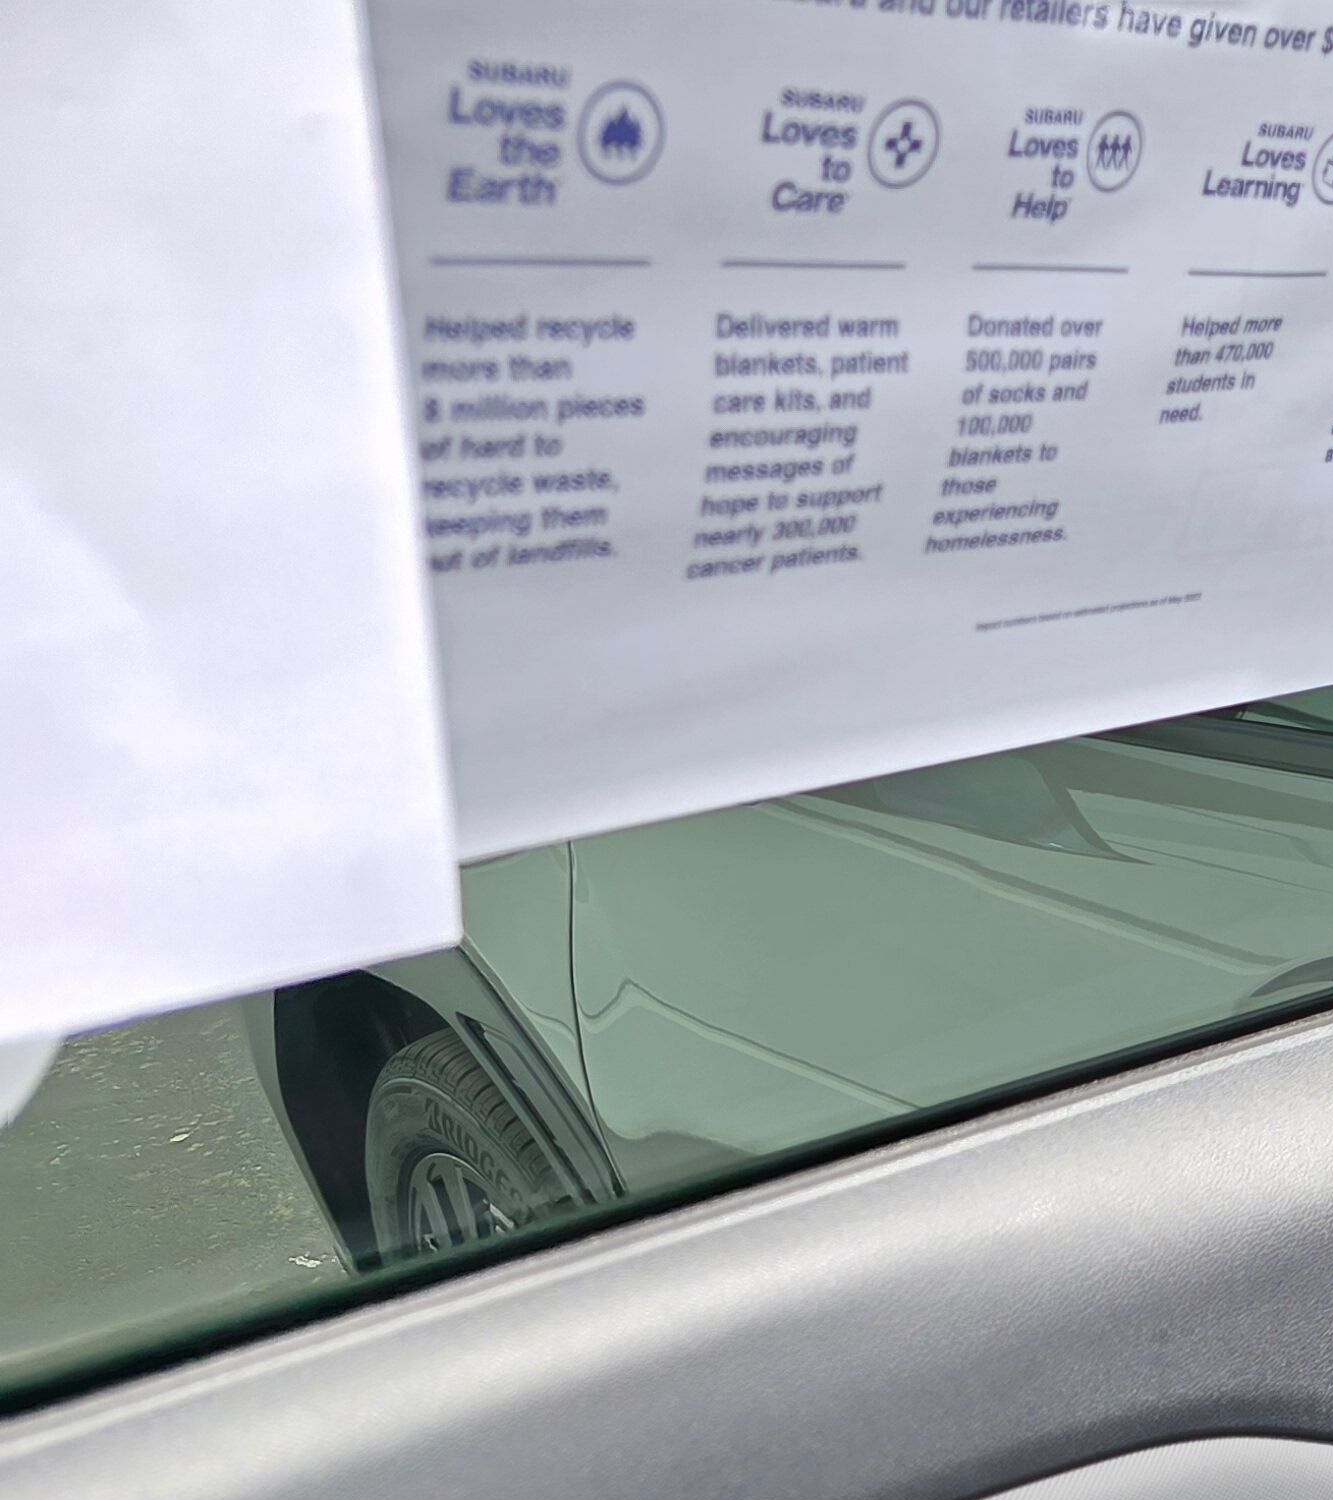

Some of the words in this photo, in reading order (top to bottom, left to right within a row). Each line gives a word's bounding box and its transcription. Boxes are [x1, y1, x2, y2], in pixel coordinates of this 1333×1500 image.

[1000, 0, 1108, 29] retailers
[1117, 0, 1182, 37] have
[1188, 12, 1257, 48] given
[1263, 27, 1316, 53] over
[467, 60, 573, 88] SUBARU
[447, 83, 567, 129] Loves
[780, 87, 866, 113] SUBARU
[761, 110, 858, 149] Loves
[1024, 108, 1084, 125] SUBARU
[1007, 128, 1080, 159] Loves
[1257, 123, 1316, 142] SUBARU
[499, 133, 561, 168] the
[1240, 140, 1307, 171] Loves
[821, 154, 852, 183] to
[1051, 163, 1075, 189] to
[447, 167, 557, 205] Earth
[771, 180, 846, 213] Care
[1202, 169, 1302, 208] Learning
[1011, 191, 1070, 224] Help
[423, 314, 528, 347] Helped
[535, 314, 637, 348] recycle
[715, 313, 831, 340] Delivered
[838, 317, 899, 338] warm
[967, 313, 1055, 338] Donated
[1060, 318, 1104, 338] over
[1181, 315, 1242, 341] Helped
[1243, 317, 1284, 334] more
[714, 352, 825, 378] blankets,
[830, 351, 910, 380] patient
[964, 349, 1044, 375] 500,000
[1048, 350, 1097, 376] pairs
[1174, 347, 1211, 367] than
[1215, 341, 1275, 363] 470,000
[421, 360, 498, 381] more
[508, 355, 573, 382] than
[1165, 372, 1237, 395] students
[1240, 369, 1256, 390] in
[713, 392, 766, 414] care
[774, 387, 822, 414] kits,
[828, 387, 873, 411] and
[961, 382, 984, 405] of
[988, 381, 1047, 404] socks
[1052, 380, 1090, 402] and
[557, 394, 646, 426] pieces
[1158, 401, 1203, 425] need.
[709, 423, 859, 451] encouraging
[957, 413, 1034, 437] 100,000
[420, 437, 452, 462] of
[460, 434, 526, 460] hard
[533, 434, 564, 458] to
[948, 444, 1034, 468] blankets
[1038, 442, 1059, 463] to
[704, 458, 825, 484] messages
[831, 453, 856, 476] of
[422, 471, 523, 504] recycle
[532, 467, 621, 496] waste,
[940, 477, 998, 498] those
[700, 496, 760, 520] hope
[767, 492, 790, 512] to
[795, 483, 884, 509] support
[932, 496, 1061, 528] experiencing
[541, 506, 608, 530] them
[693, 526, 763, 549] nearly
[772, 515, 858, 540] 300,000
[924, 526, 1068, 555] homelessness.
[470, 547, 500, 570] of
[685, 555, 763, 580] cancer
[769, 545, 862, 574] patients.
